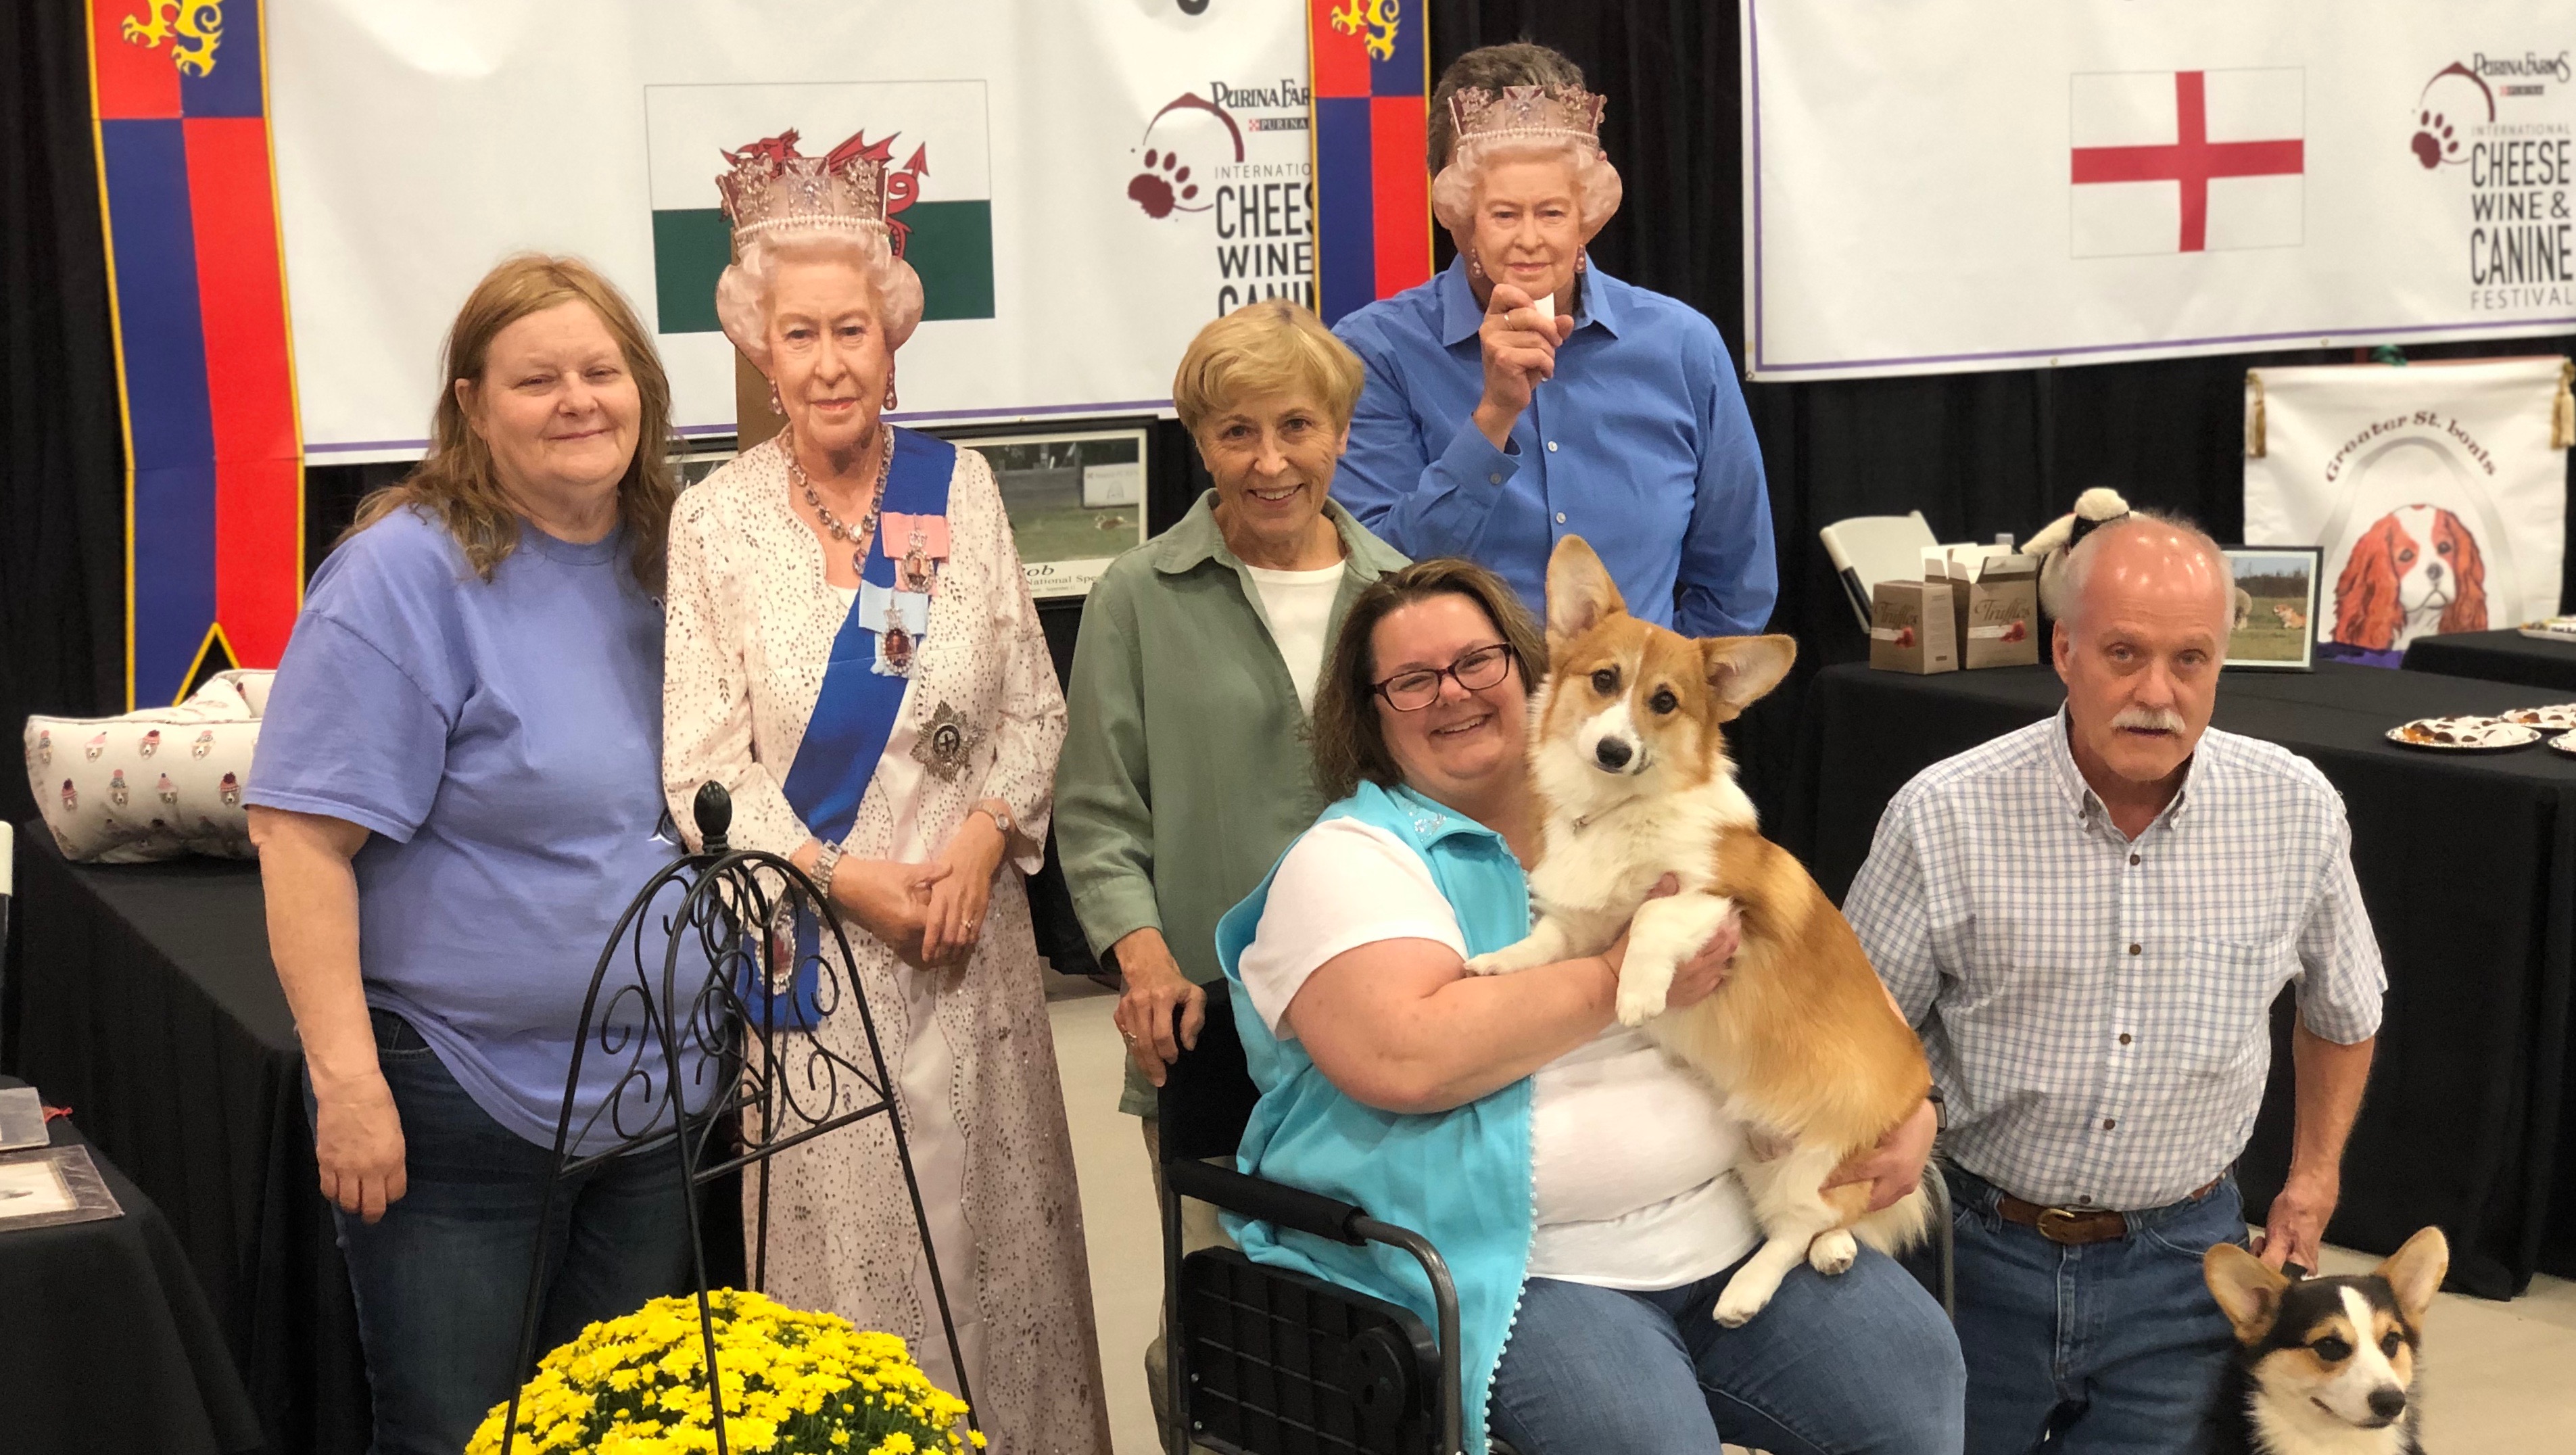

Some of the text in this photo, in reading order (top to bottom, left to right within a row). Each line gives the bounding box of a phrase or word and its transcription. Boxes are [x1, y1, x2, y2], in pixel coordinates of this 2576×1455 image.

[1280, 78, 1310, 108] FAR
[1261, 118, 1306, 130] PURINA
[2471, 123, 2571, 137] INTERNATIONAL
[1215, 162, 1312, 179] INTERNATIO
[2472, 140, 2571, 189] CHEESE
[1216, 182, 1313, 239] CHEE
[2471, 191, 2571, 222] WINE &
[1217, 241, 1313, 279] WINE
[2471, 224, 2573, 286] CANINE
[2471, 286, 2573, 310] FESTIVAL
[2326, 415, 2408, 482] Greater
[2412, 410, 2441, 429] St.
